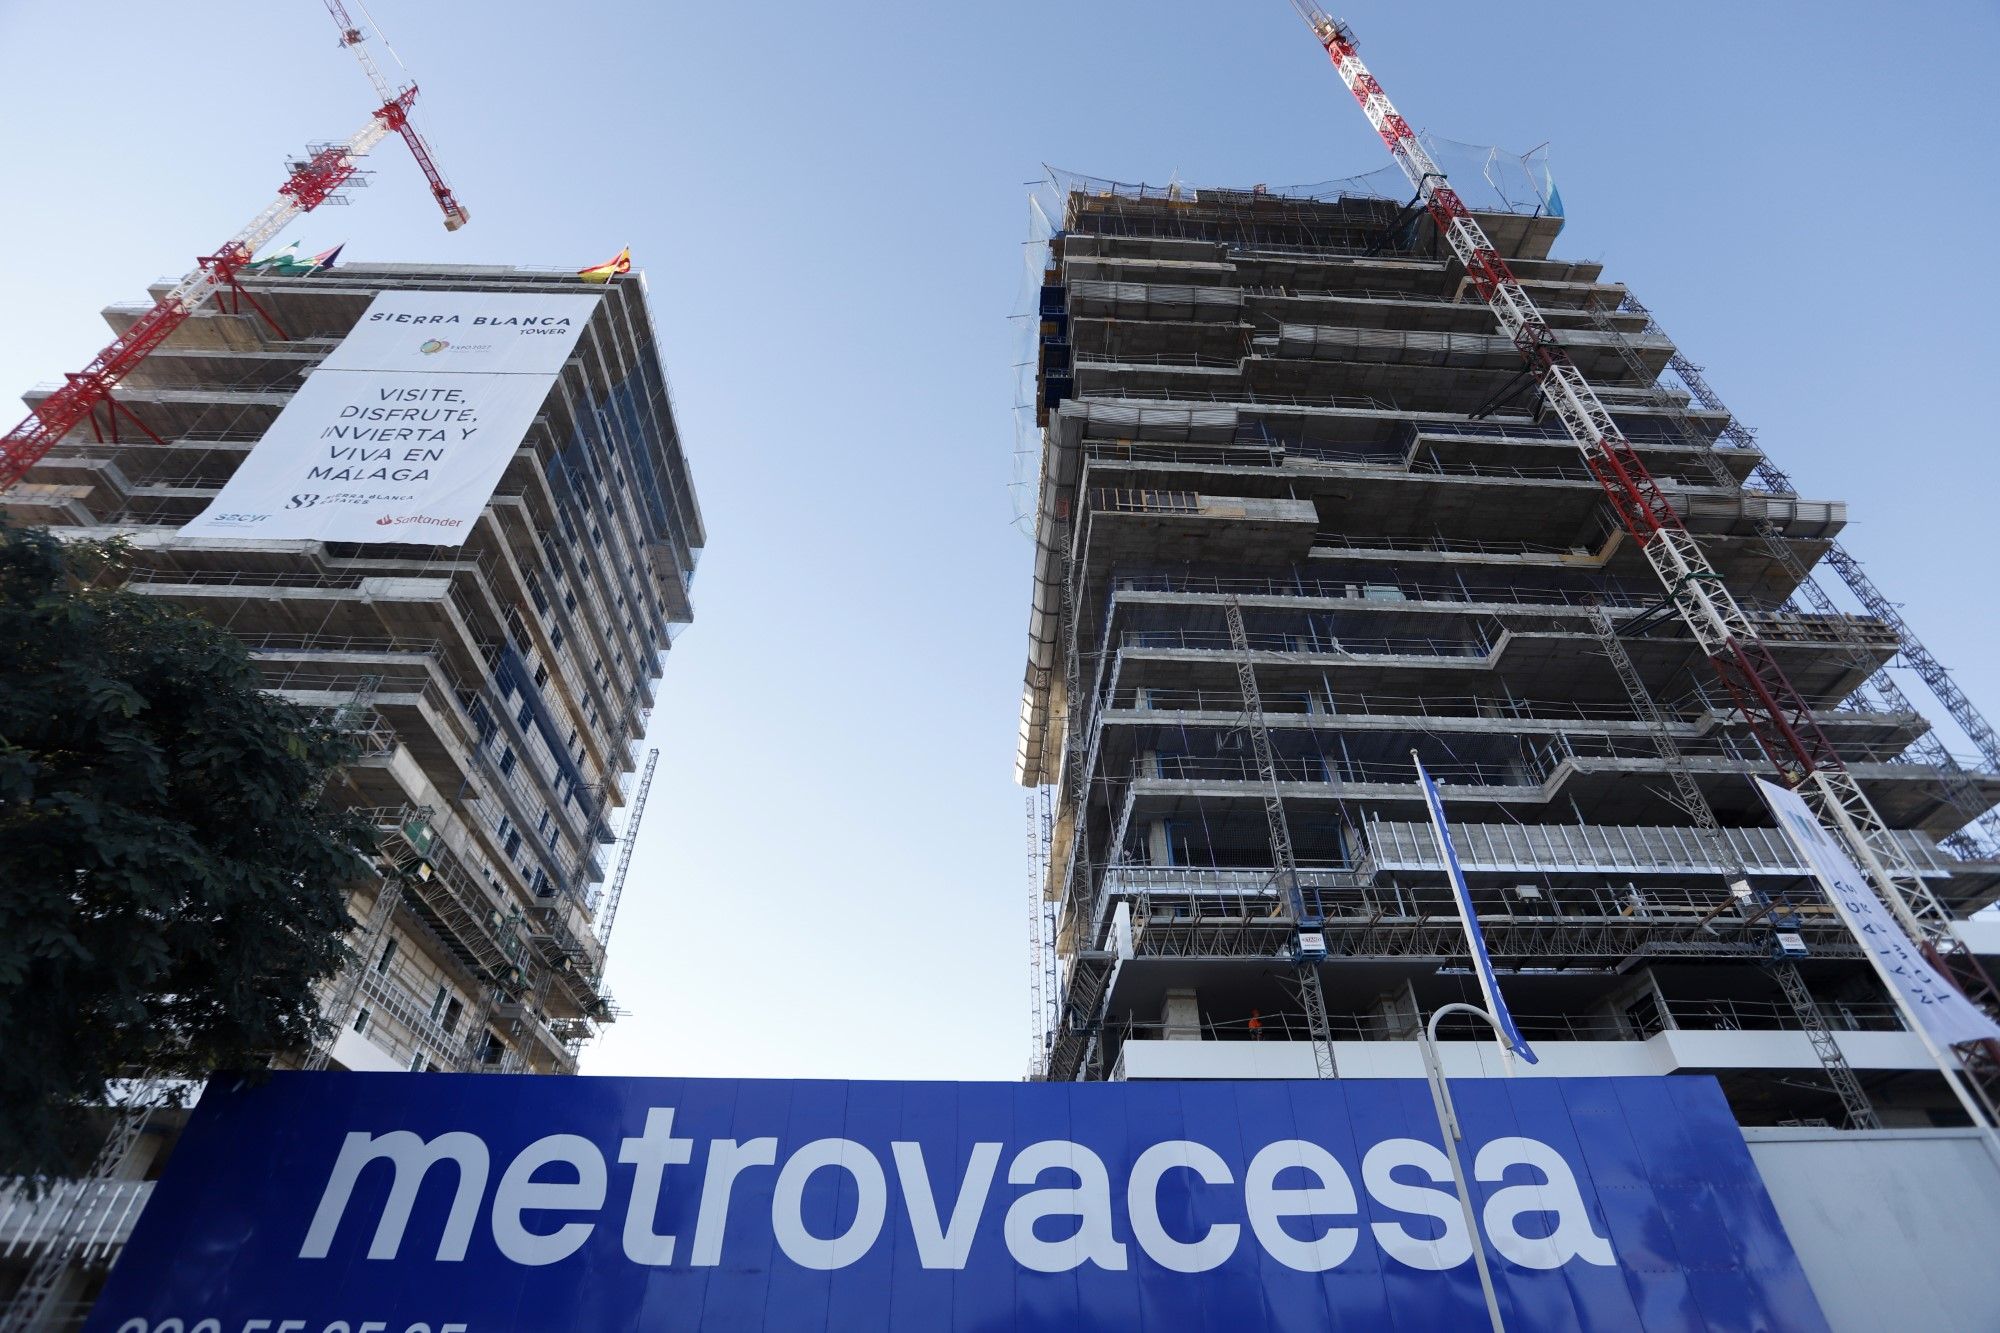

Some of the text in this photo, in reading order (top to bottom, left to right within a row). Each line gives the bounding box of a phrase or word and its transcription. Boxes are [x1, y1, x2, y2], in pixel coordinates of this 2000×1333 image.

[370, 313, 571, 326] SIERRA BLANCA
[380, 388, 466, 404] VISITE,
[340, 405, 478, 422] DISFRUTE,
[320, 425, 477, 442] INVIERTA Y
[330, 445, 444, 462] VIVA EN
[306, 465, 429, 481] MÁLAGA
[393, 514, 464, 528] Santander
[299, 1107, 1616, 1273] metrovacesa
